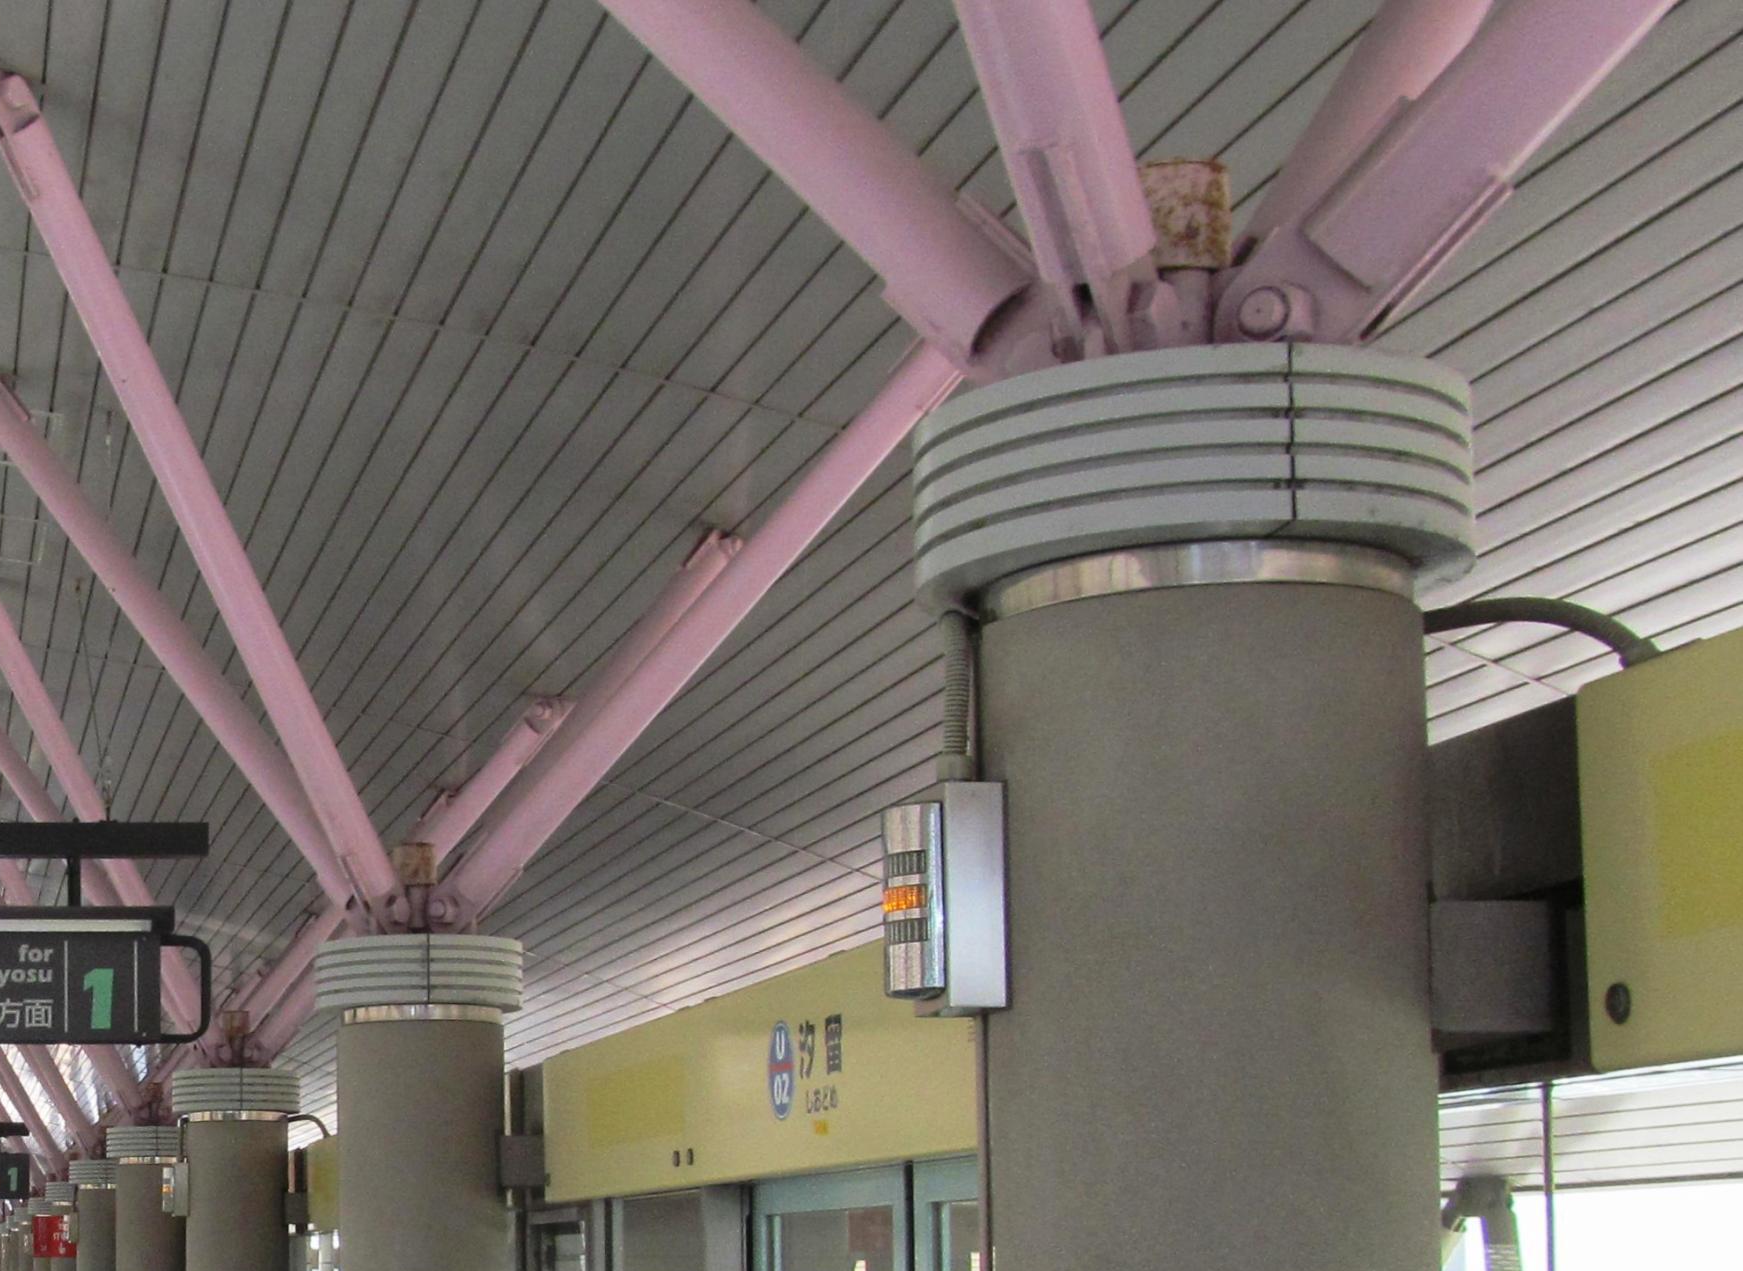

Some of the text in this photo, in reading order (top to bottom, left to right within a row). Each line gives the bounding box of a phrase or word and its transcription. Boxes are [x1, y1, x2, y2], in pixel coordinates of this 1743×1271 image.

[19, 944, 53, 963] for
[83, 968, 114, 1029] 1
[775, 1030, 785, 1060] U
[798, 1013, 842, 1080] 汐留
[774, 1072, 790, 1105] 02
[7, 1167, 19, 1191] 1
